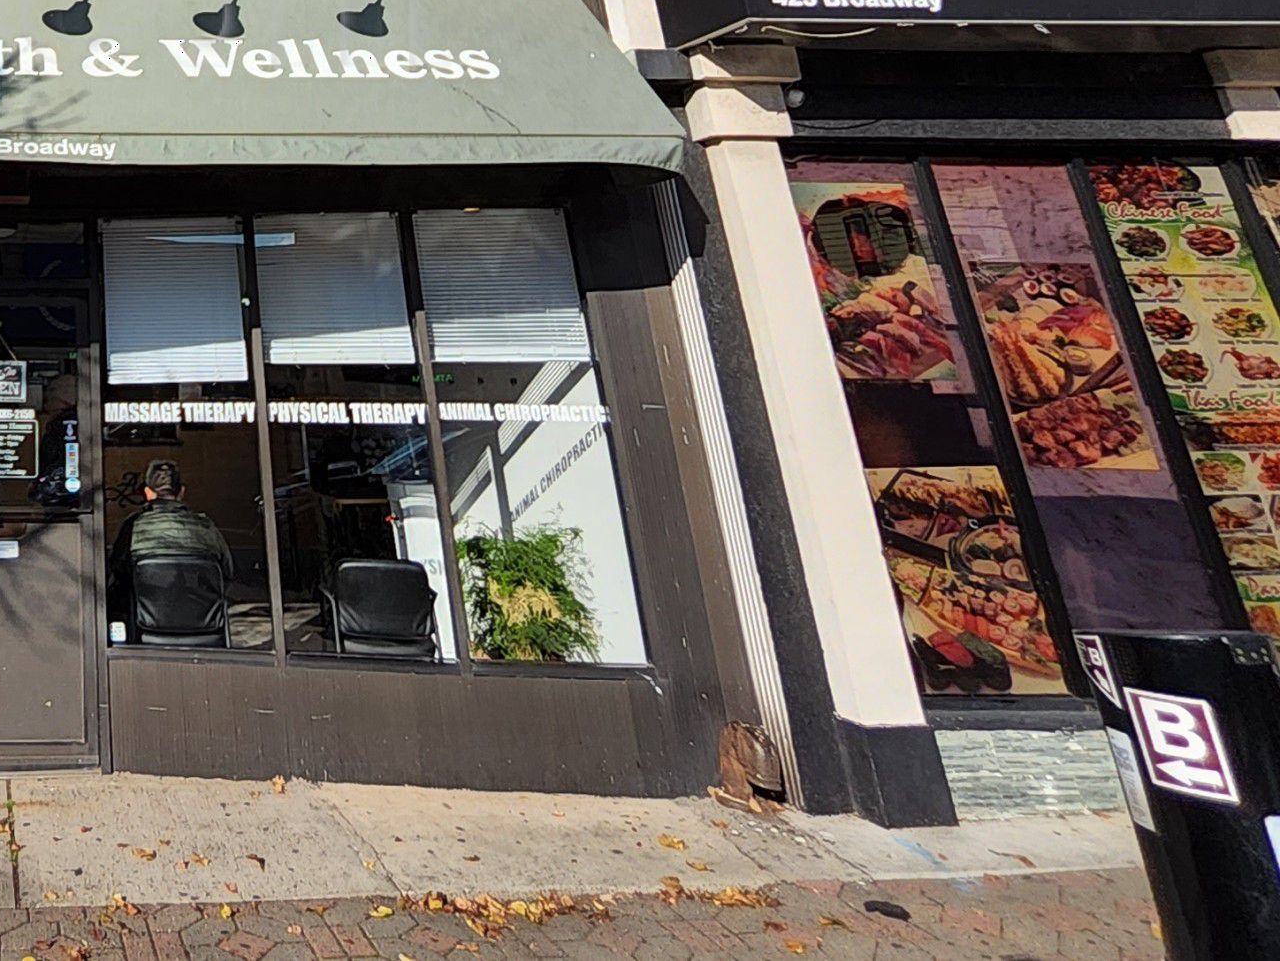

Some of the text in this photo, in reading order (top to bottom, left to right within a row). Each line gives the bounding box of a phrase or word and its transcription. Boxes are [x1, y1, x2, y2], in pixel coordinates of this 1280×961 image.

[81, 37, 143, 78] &
[159, 38, 501, 80] Wellness
[1106, 200, 1224, 220] Chinese Food
[1184, 389, 1279, 409] Thai Food
[104, 402, 255, 423] MASSAGE THERAPY
[268, 401, 426, 424] PHYSICAL THERAPY
[439, 402, 611, 424] ANIMAL CHIROPRACTIC
[1138, 696, 1207, 760] B
